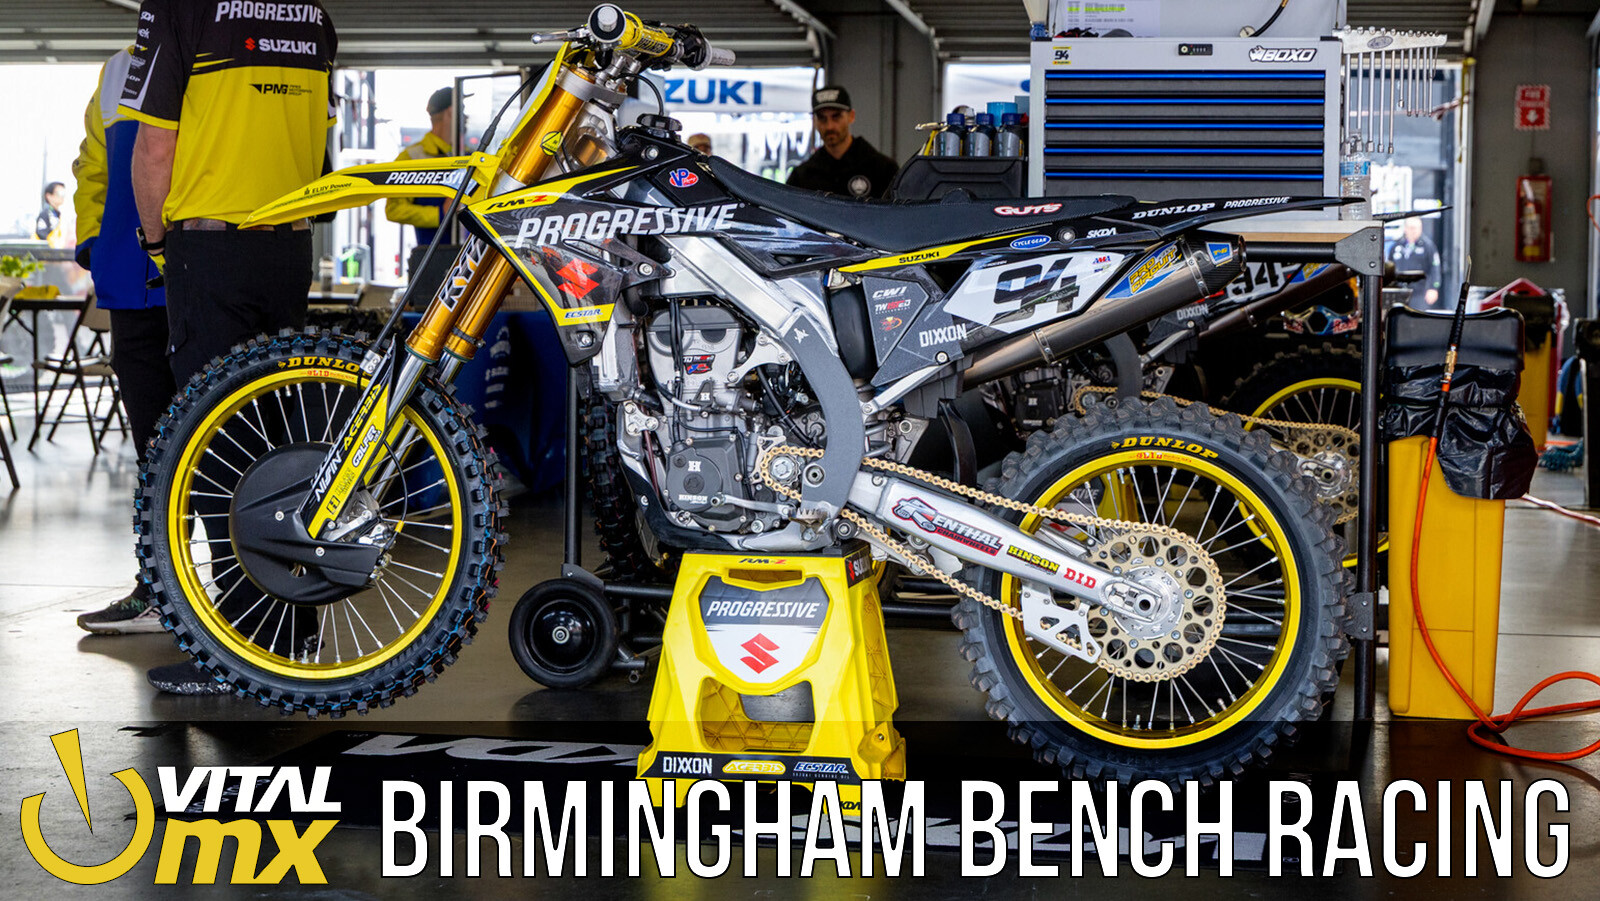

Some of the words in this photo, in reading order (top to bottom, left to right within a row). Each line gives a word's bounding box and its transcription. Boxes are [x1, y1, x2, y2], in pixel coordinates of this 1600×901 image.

[215, 1, 323, 25] PROGRESSIVE
[259, 38, 317, 55] SUZUKI
[1262, 48, 1316, 62] BOXO
[665, 79, 762, 105] ZUKI
[385, 172, 466, 184] PROGRESSI
[670, 168, 690, 187] VP
[486, 195, 548, 211] RM-Z
[994, 203, 1062, 215] GUTS
[1132, 202, 1216, 220] DUNLOP
[1223, 197, 1290, 209] PROGRESSIVE
[515, 203, 739, 249] PROGRESSIVE
[1086, 227, 1118, 238] SKDA
[1013, 239, 1031, 247] CYCLE
[1031, 237, 1048, 245] GEAR
[898, 251, 940, 264] SUZUKI
[1129, 256, 1156, 284] PRO
[1131, 248, 1177, 293] CIRCUIT
[988, 256, 1081, 327] 94
[564, 309, 602, 318] ECSTAR
[1176, 305, 1209, 321] DIXXON
[919, 323, 968, 348] DIXXON
[287, 356, 373, 377] DUNLO
[344, 383, 381, 451] ACERBIS
[1121, 436, 1219, 459] DUNLOP
[937, 528, 997, 555] CHAINWHEELS
[1007, 545, 1060, 572] HINSON
[706, 600, 820, 618] PROGRESSIVE
[663, 756, 713, 775] DIXXON
[724, 761, 786, 774] ACERBIS
[794, 761, 849, 774] ECSTAR
[841, 801, 860, 811] KDA
